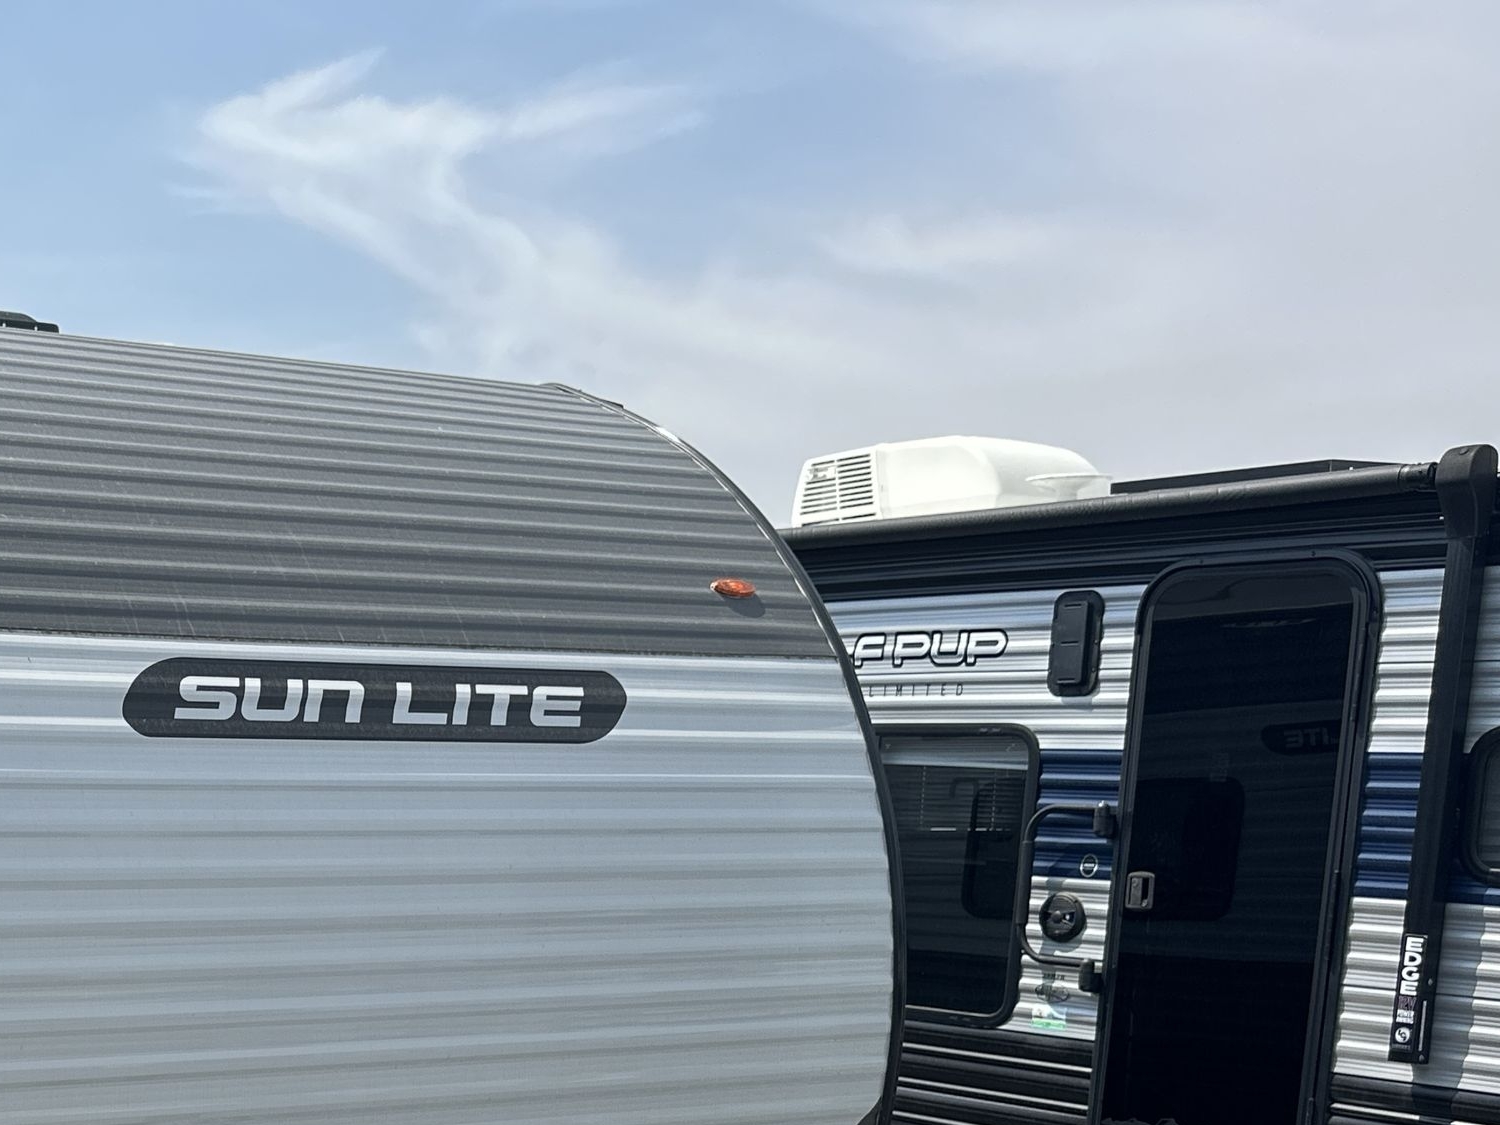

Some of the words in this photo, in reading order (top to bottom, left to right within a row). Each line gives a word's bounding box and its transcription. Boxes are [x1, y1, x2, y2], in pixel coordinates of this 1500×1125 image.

[892, 628, 1009, 668] PUP
[173, 675, 366, 723] SUN
[392, 681, 585, 728] LITE
[868, 683, 964, 697] LIMITED
[1400, 936, 1424, 996] EDGE
